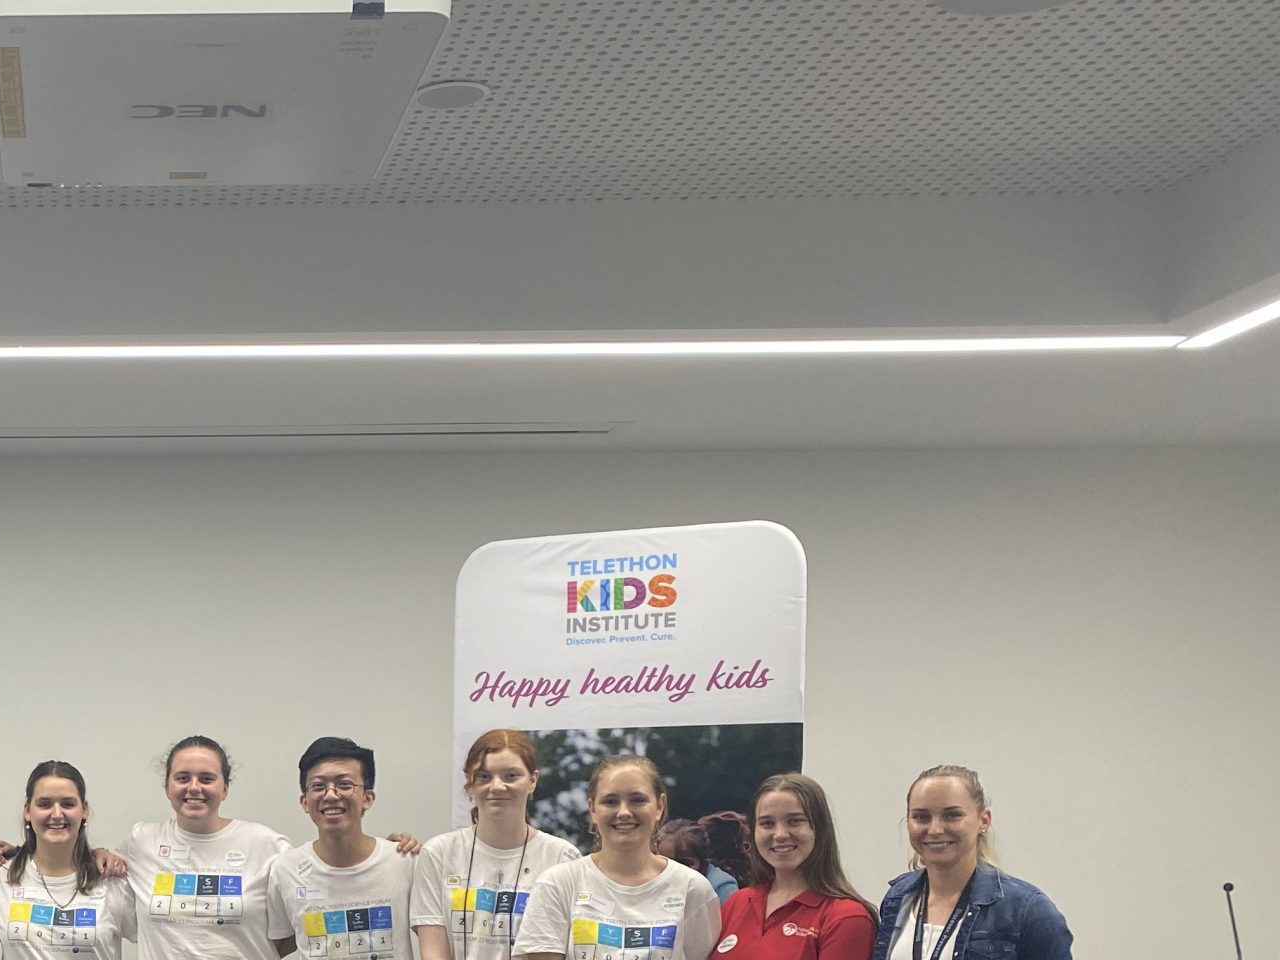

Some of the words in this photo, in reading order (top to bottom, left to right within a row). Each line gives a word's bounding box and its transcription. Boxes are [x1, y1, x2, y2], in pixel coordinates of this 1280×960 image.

[131, 104, 267, 118] NEC
[567, 553, 677, 577] TELETHON
[566, 574, 678, 614] KIDS
[566, 612, 676, 634] INSTITUTE
[566, 638, 607, 646] Discover.
[609, 634, 648, 643] Prevent.
[469, 670, 570, 708] Happy
[579, 664, 696, 703] healthy
[705, 659, 774, 692] kids
[502, 894, 508, 902] S
[355, 913, 361, 921] S
[498, 921, 504, 929] 2
